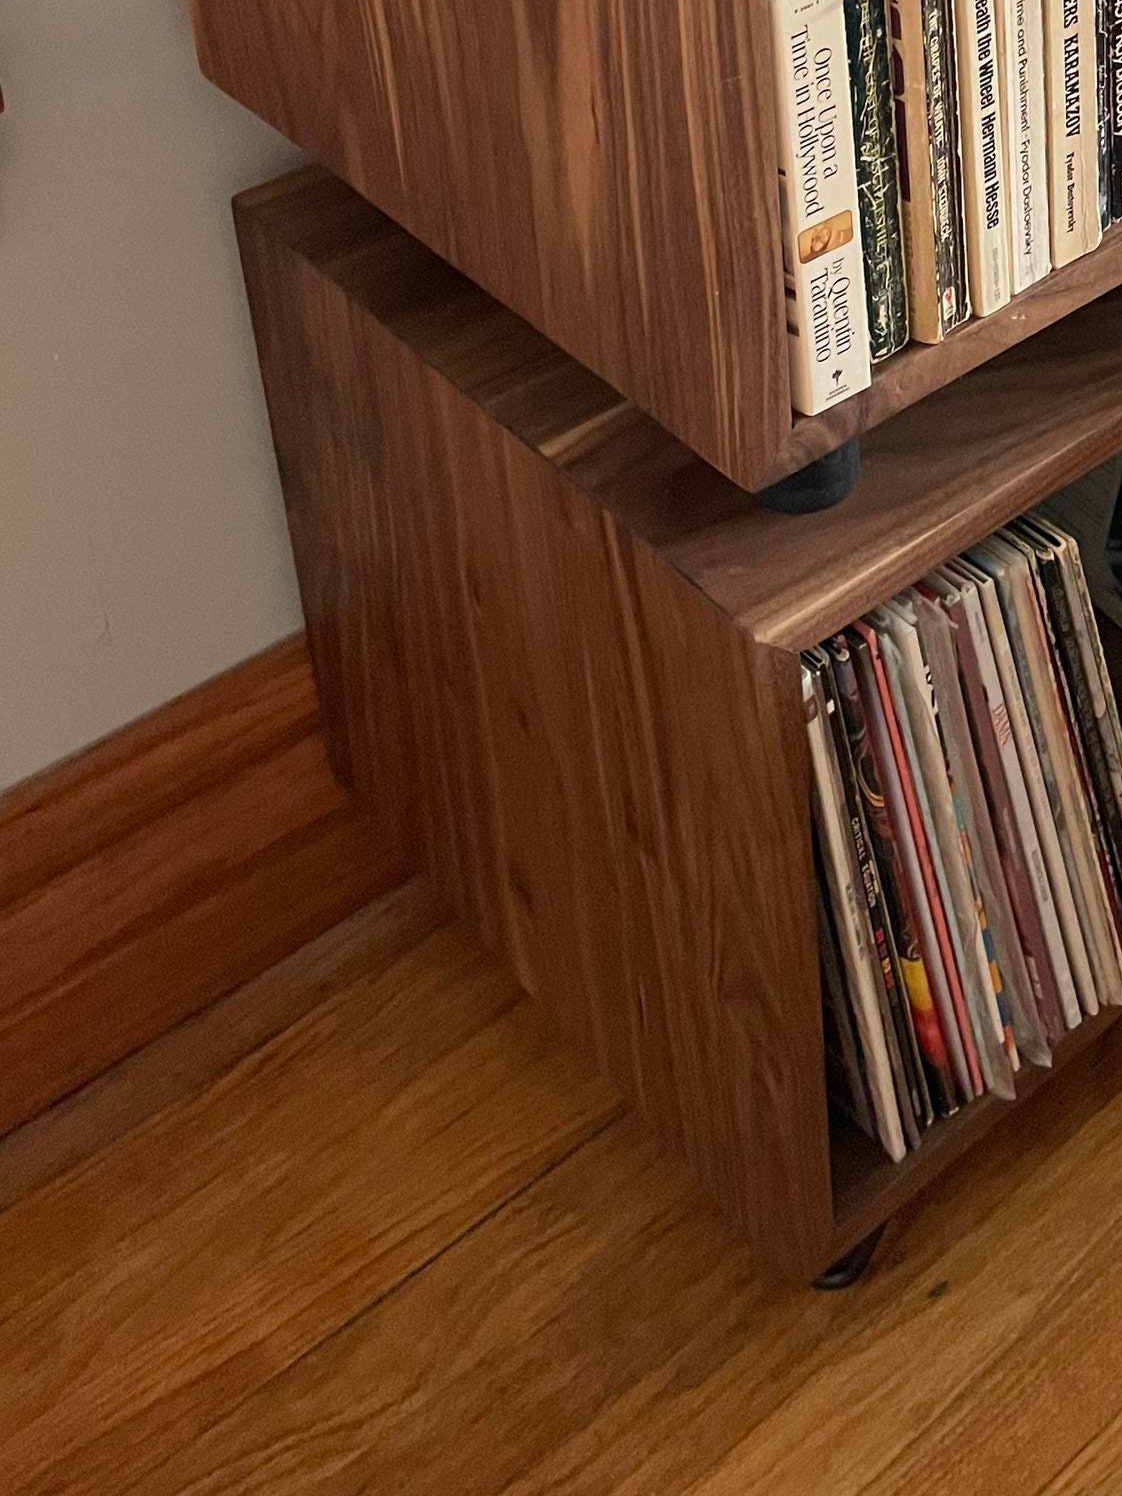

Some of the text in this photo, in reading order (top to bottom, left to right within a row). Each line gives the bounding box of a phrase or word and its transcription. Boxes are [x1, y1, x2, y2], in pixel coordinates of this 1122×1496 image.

[928, 8, 941, 35] THE
[977, 32, 993, 62] the
[1017, 27, 1028, 56] and
[790, 24, 811, 81] Time
[930, 35, 942, 82] GRAPES
[795, 81, 815, 104] in
[932, 83, 943, 100] OF
[979, 59, 996, 111] Wheel
[1017, 57, 1031, 134] Punishment
[1063, 32, 1081, 139] KARAMAZOV
[813, 47, 839, 180] Once Upon a
[795, 106, 824, 218] Hollywood
[981, 110, 1000, 184] Hermann
[1019, 138, 1031, 185] Fyodor
[1064, 150, 1075, 182] Fyodor
[984, 180, 1001, 231] Hesse
[1022, 184, 1035, 256] Dostoevsky
[1065, 182, 1077, 234] Dostoyevsky
[809, 267, 834, 364] Tarantino
[827, 257, 856, 356] by Quentin
[851, 816, 867, 862] CRITICAL
